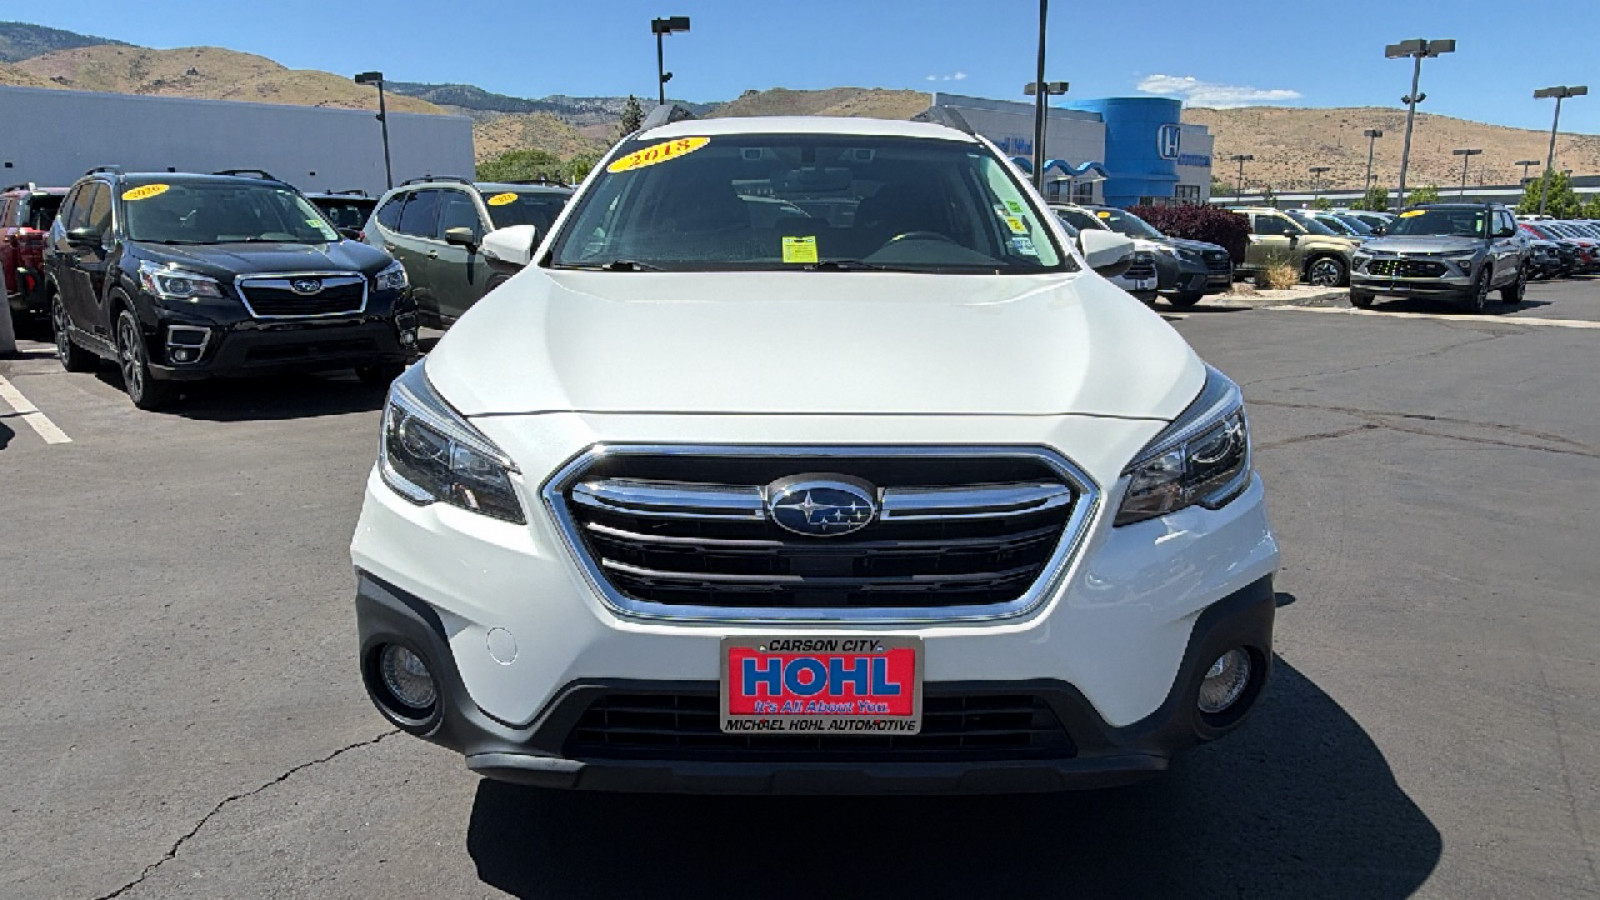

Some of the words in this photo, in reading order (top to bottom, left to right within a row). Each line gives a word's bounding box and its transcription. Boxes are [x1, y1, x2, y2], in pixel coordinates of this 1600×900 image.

[629, 140, 690, 167] 2018
[769, 640, 837, 651] CARSON
[841, 640, 879, 651] CITY
[742, 657, 900, 696] HOHL
[754, 700, 778, 713] It's
[780, 700, 803, 713] All
[804, 700, 853, 713] About
[725, 720, 785, 731] MICHAEL
[789, 720, 825, 731] HOHL
[828, 720, 916, 731] AUTOMOTIVE
